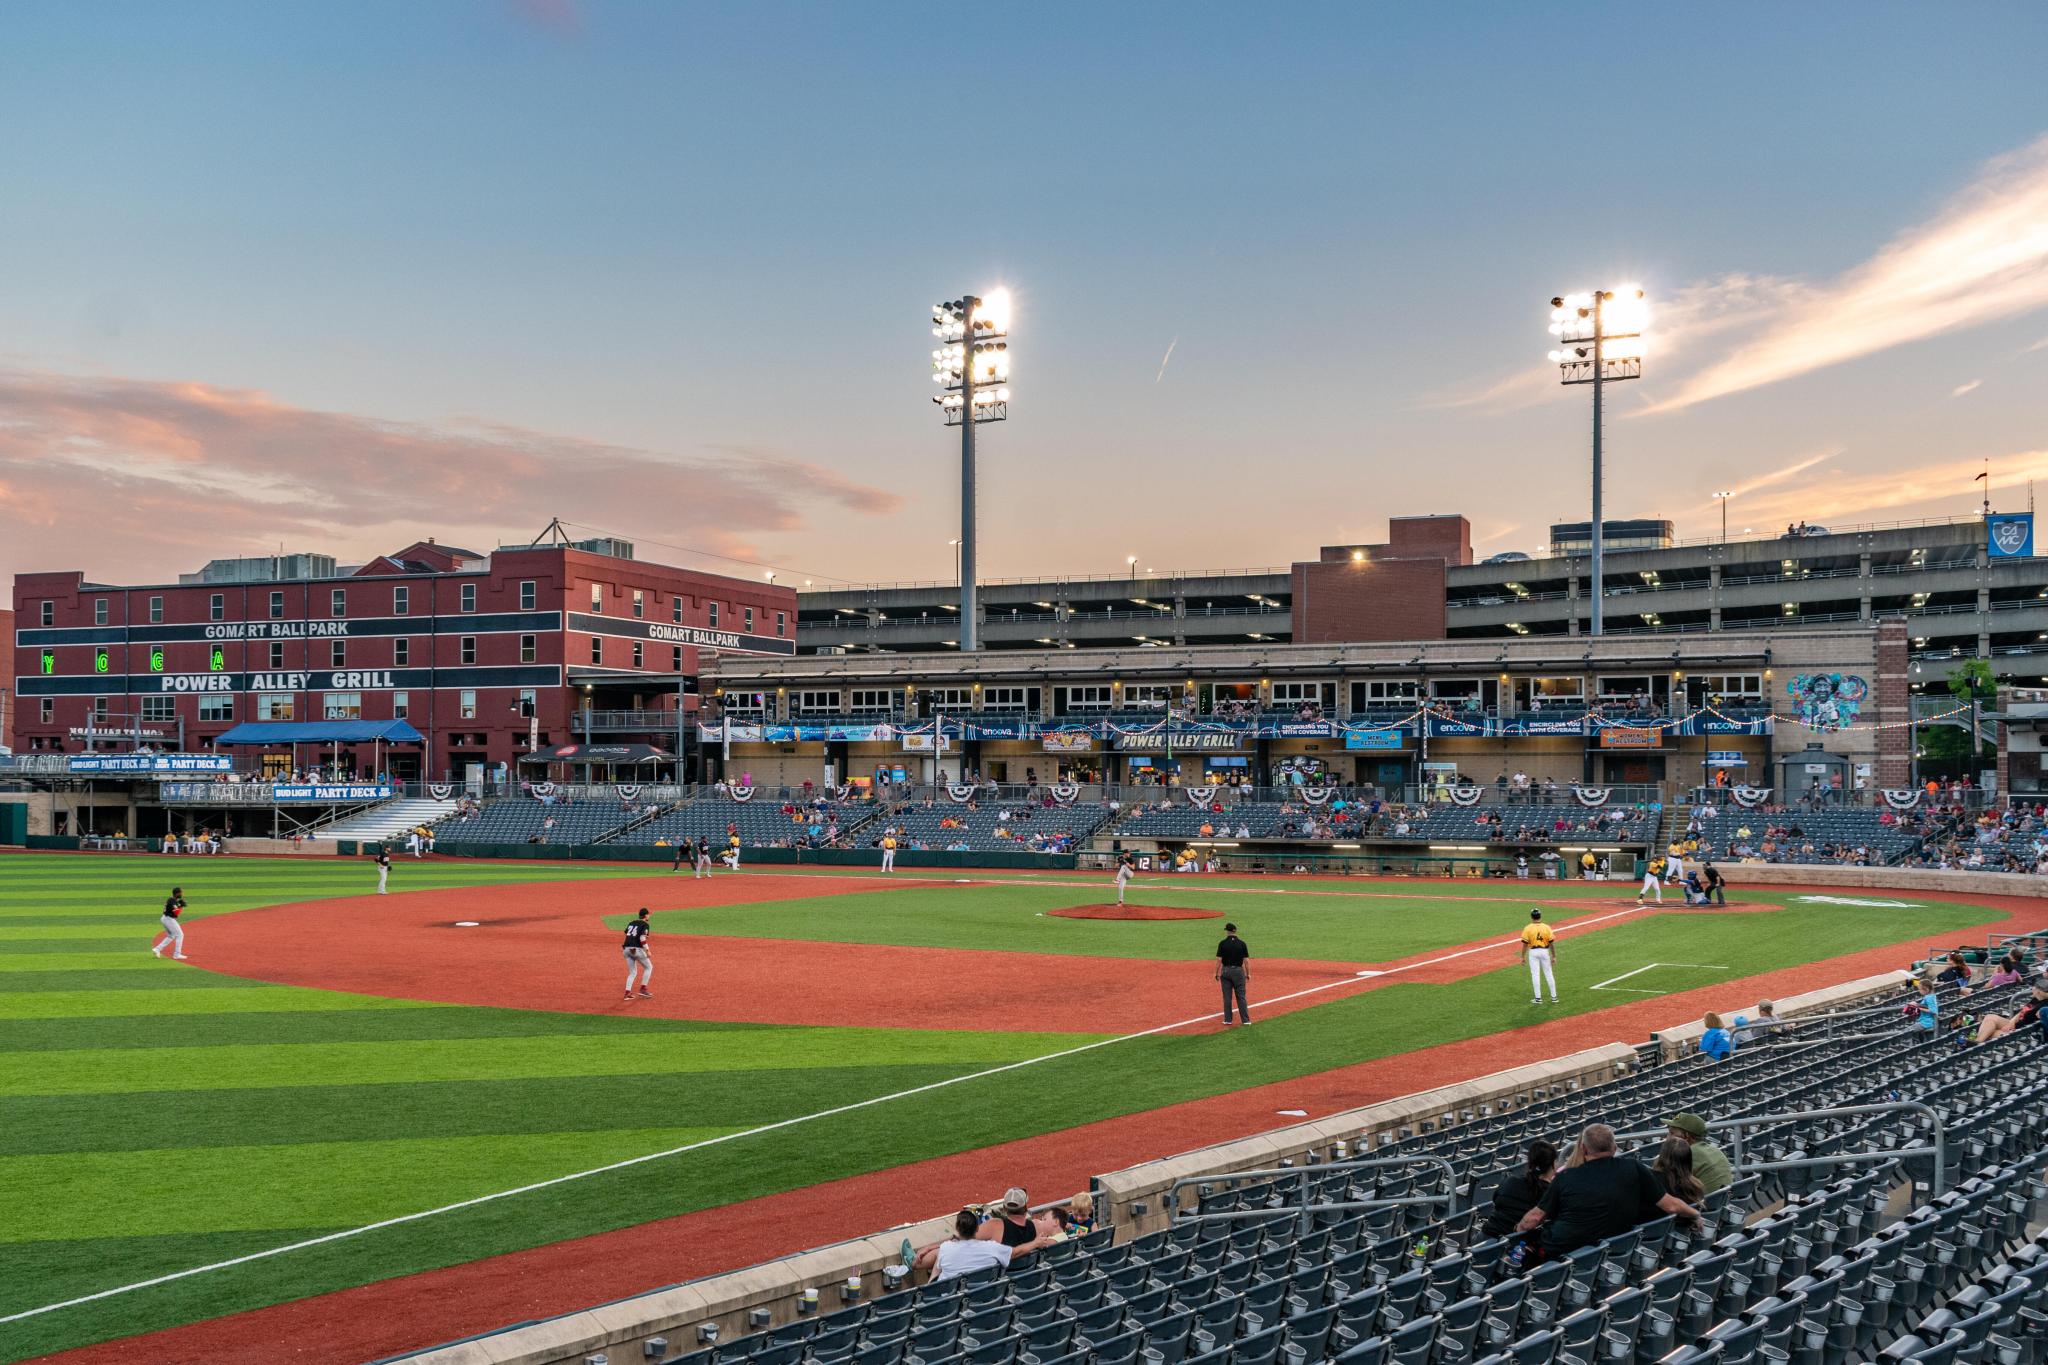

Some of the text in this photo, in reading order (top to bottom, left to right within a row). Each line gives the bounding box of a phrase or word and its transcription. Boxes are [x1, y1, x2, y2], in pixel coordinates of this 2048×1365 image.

[2001, 525, 2018, 536] CA
[1998, 535, 2020, 545] MC
[205, 621, 349, 639] GOMART BALLPARK
[649, 624, 740, 648] GOMART BALLPARK
[161, 671, 395, 692] POWER ALLEY GRILL
[1440, 724, 1476, 732] encova
[1122, 735, 1163, 747] POWER
[1203, 734, 1235, 747] GRILL
[100, 759, 121, 770] PARTY
[121, 759, 139, 769] DECK
[171, 759, 216, 769] PARTY DECK
[275, 787, 377, 798] BUD LIGHT PARTY DECK
[1138, 857, 1150, 870] 12
[1536, 932, 1544, 943] 4
